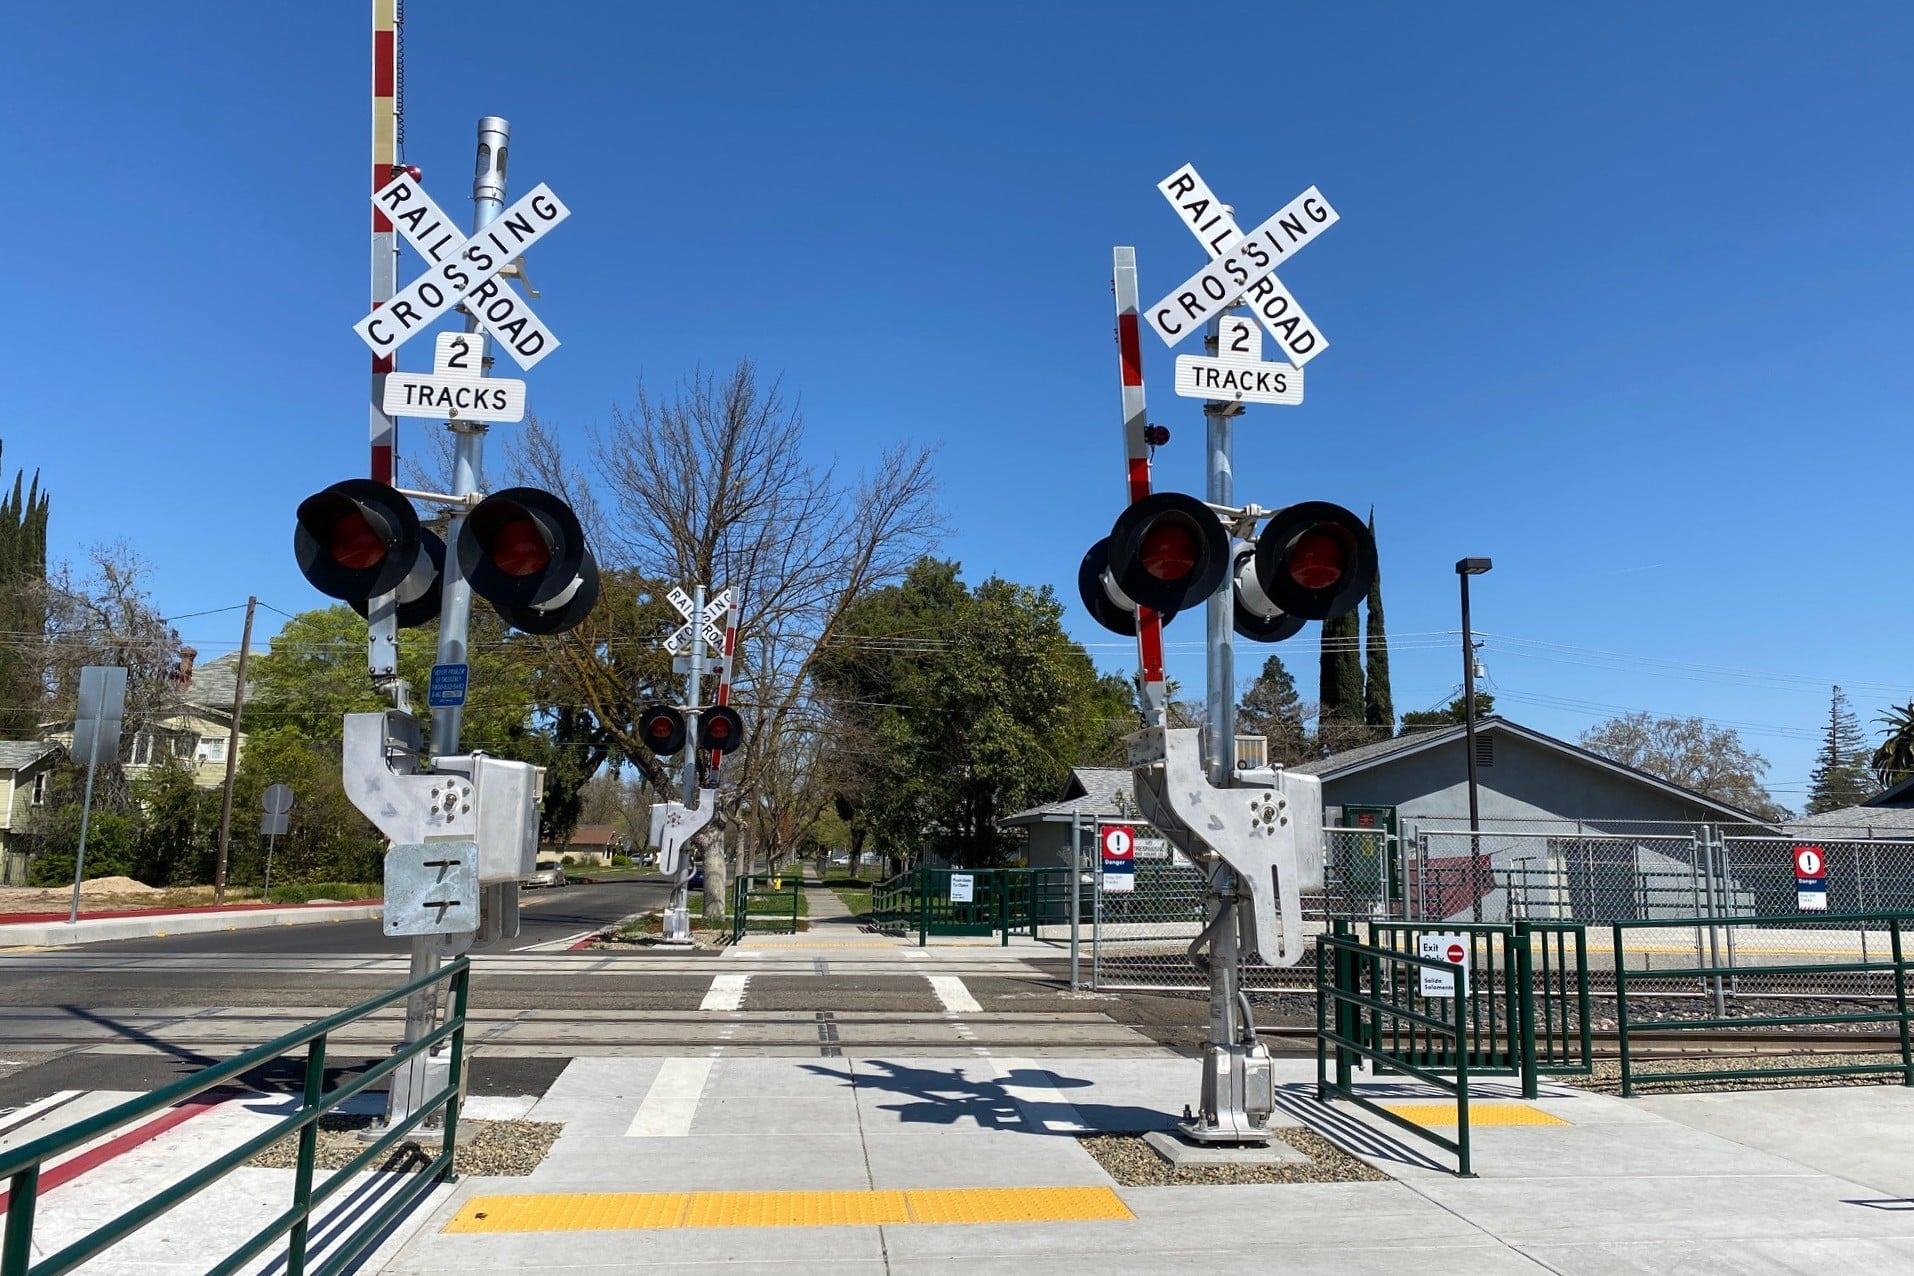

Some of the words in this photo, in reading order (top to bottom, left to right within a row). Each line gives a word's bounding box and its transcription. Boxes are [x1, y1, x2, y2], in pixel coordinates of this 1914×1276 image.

[367, 195, 558, 345] CROSSING
[381, 182, 453, 262] RAIL
[468, 278, 544, 357] ROAD
[1157, 198, 1328, 335] CROSSING
[1167, 172, 1232, 255] RAIL
[1247, 276, 1315, 355] ROAD
[1231, 325, 1250, 352] 2
[447, 341, 470, 368] 2
[1192, 366, 1287, 393] TRACKS
[403, 384, 507, 410] TRACKS
[702, 625, 726, 653] ROA
[1423, 943, 1439, 952] Exit
